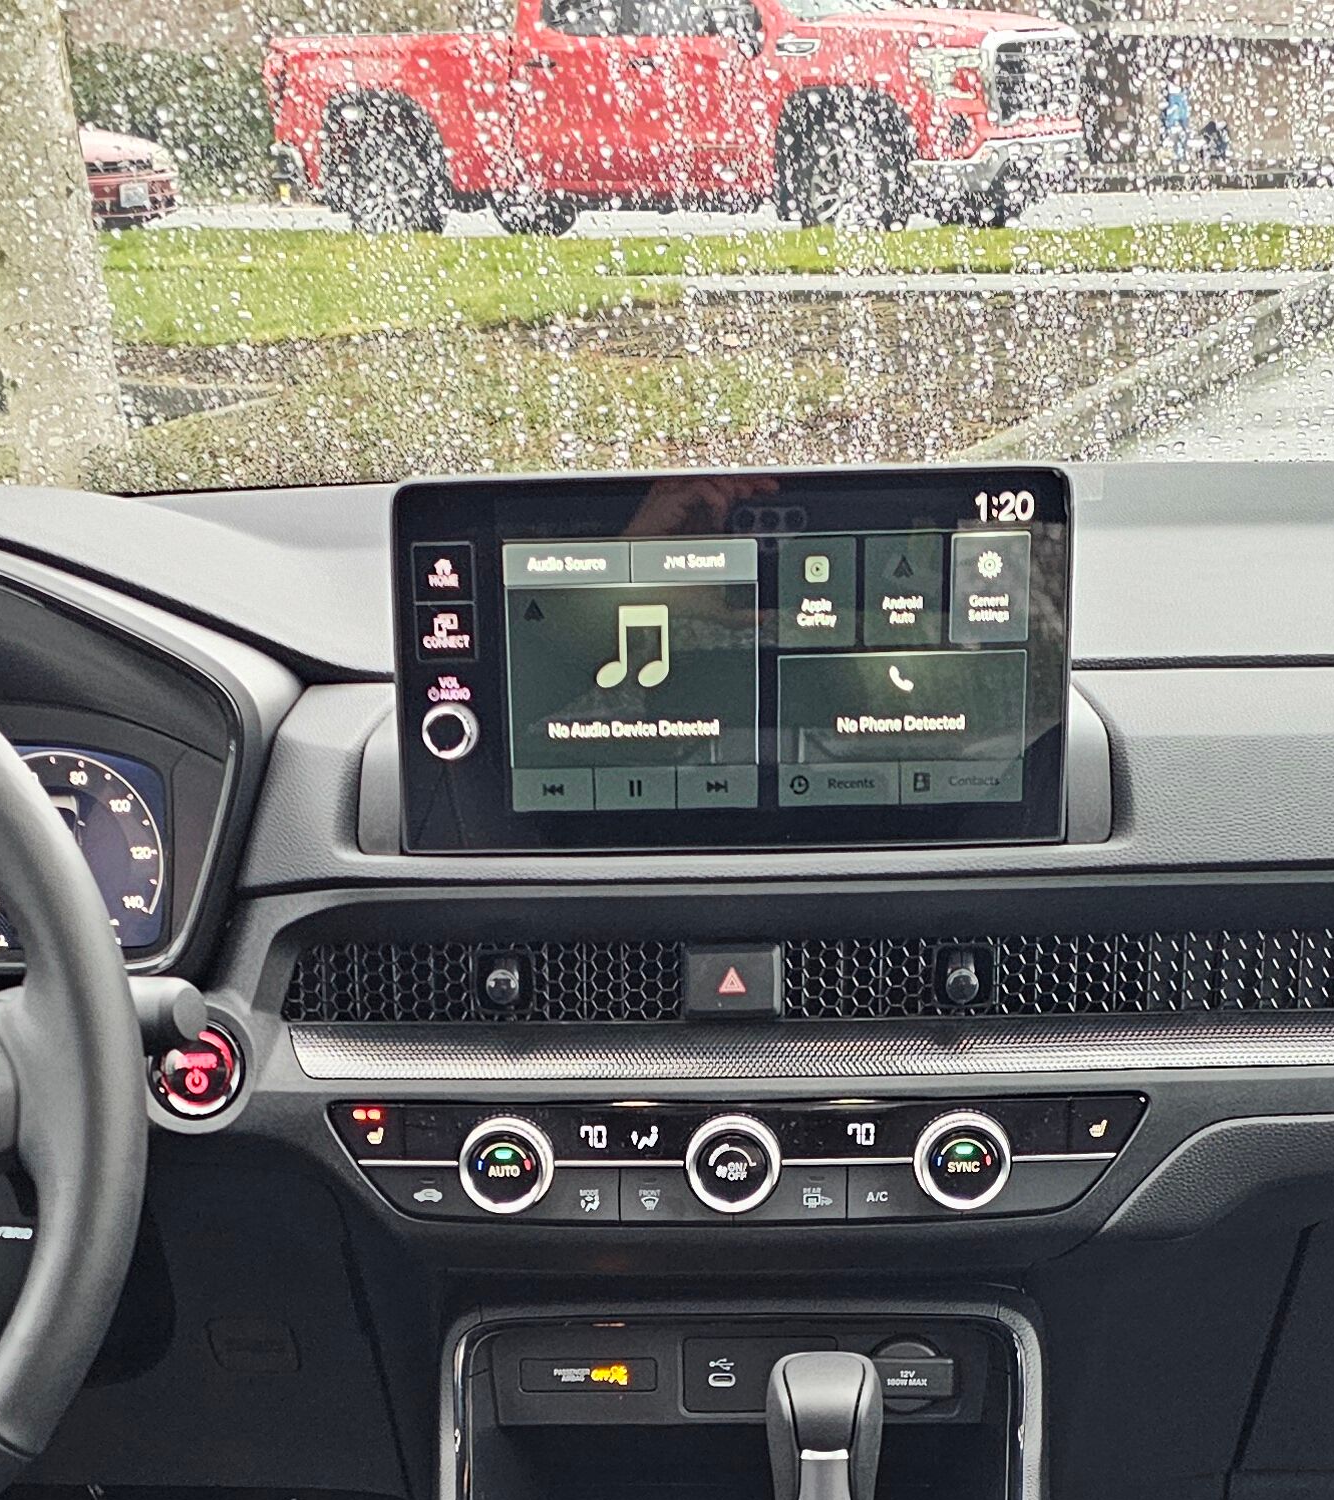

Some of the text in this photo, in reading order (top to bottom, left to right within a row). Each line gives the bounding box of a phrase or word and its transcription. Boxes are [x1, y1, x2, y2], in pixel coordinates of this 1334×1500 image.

[975, 491, 1035, 522] 1:20
[527, 557, 606, 571] Audio Source
[687, 553, 725, 569] Sound
[428, 574, 459, 587] HOME
[801, 598, 832, 613] Apple
[882, 596, 924, 610] Android
[969, 594, 1009, 608] General
[796, 612, 837, 628] CarPlay
[889, 610, 915, 624] Auto
[968, 608, 1010, 623] Settings
[423, 634, 470, 648] CONNECT
[437, 676, 460, 688] VOL
[440, 687, 471, 700] AUDIO
[548, 719, 720, 738] No Audio Device Detected
[837, 714, 965, 733] No Phone Detected
[69, 771, 88, 785] 80
[827, 777, 875, 790] Recents
[109, 799, 131, 812] 100
[130, 846, 152, 859] 120
[122, 895, 144, 908] 140
[580, 1125, 608, 1149] 70
[847, 1122, 875, 1146] 70
[488, 1164, 521, 1178] AUTO
[947, 1161, 980, 1173] SYNC
[727, 1171, 748, 1182] OFF
[639, 1189, 661, 1197] FRONT
[866, 1191, 889, 1203] A/C
[900, 1370, 915, 1378] 12V
[908, 1378, 927, 1386] MAX
